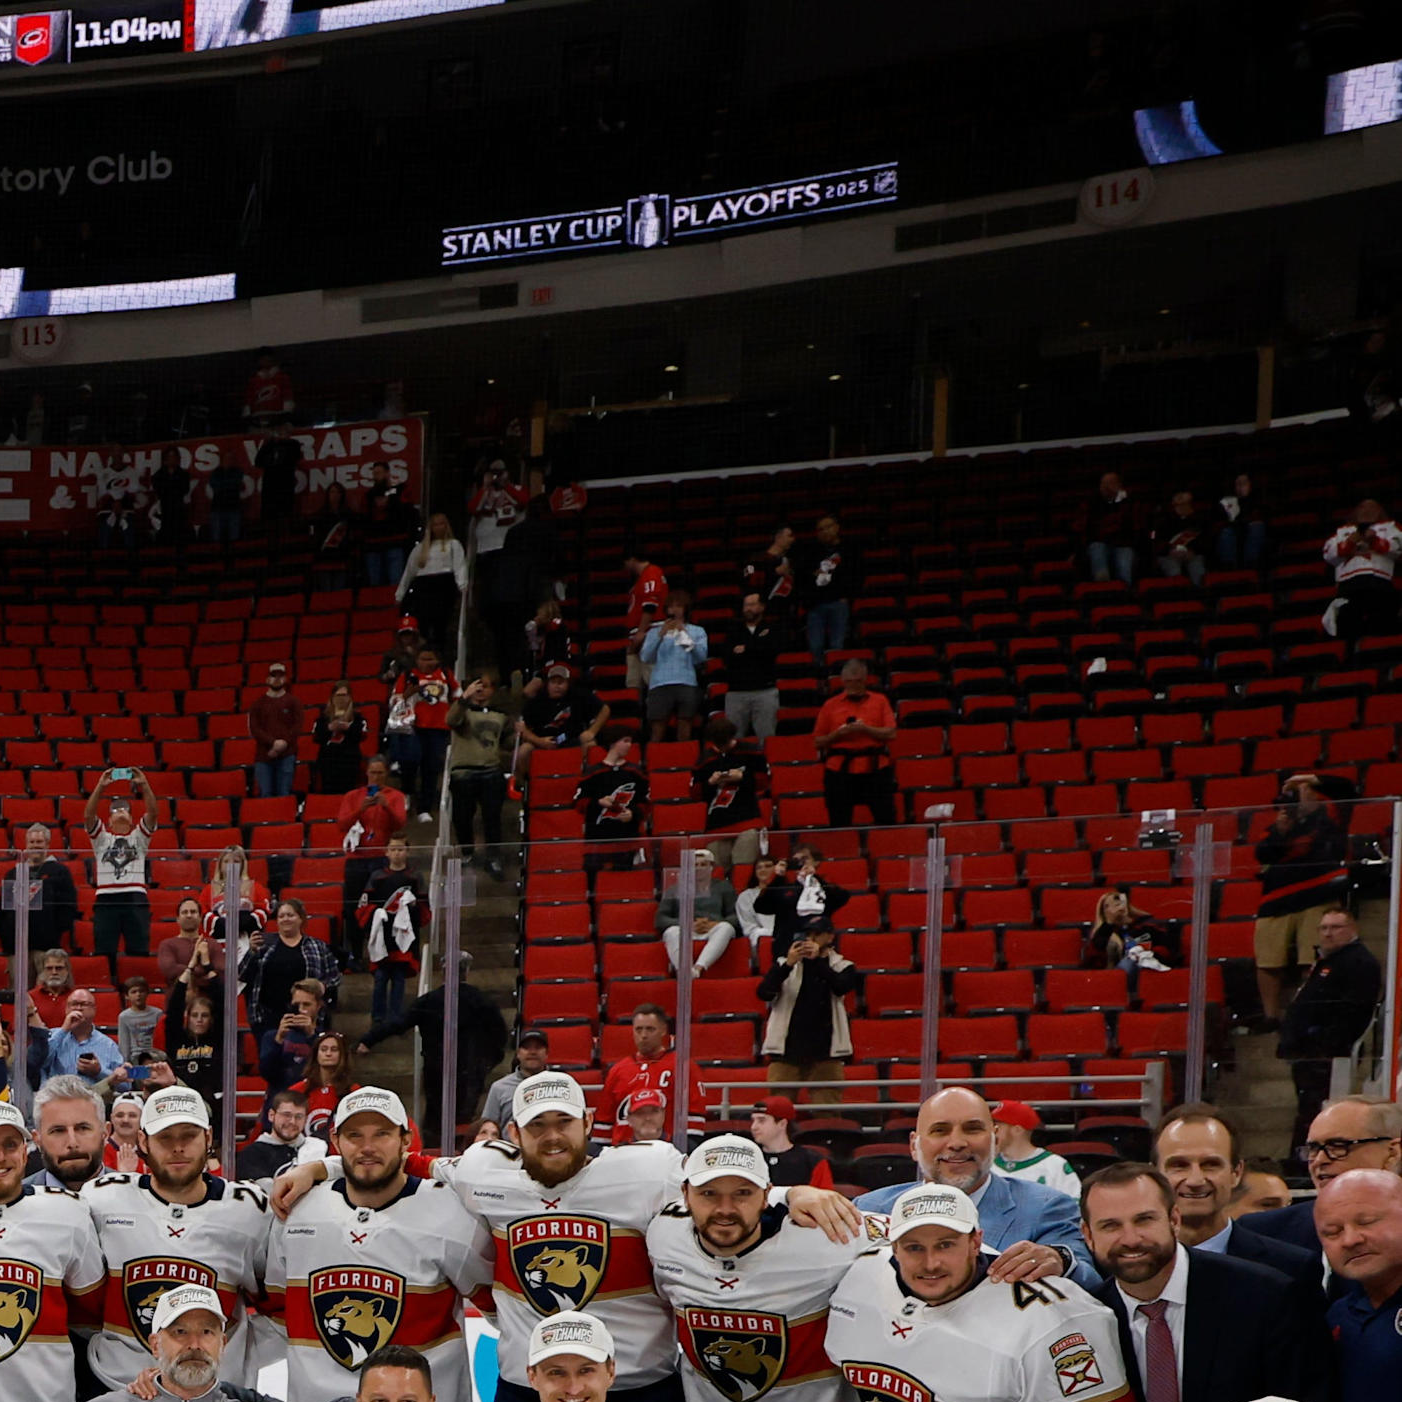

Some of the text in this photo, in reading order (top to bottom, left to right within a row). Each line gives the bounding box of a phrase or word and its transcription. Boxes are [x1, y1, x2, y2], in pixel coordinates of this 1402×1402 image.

[87, 150, 173, 185] Club
[1094, 179, 1140, 208] 114
[442, 178, 869, 258] STANLEY CUP PLAYOFFS 2025
[21, 323, 57, 347] 113
[49, 484, 76, 510] &
[358, 1097, 390, 1110] CHAMPS
[535, 1088, 570, 1102] CHAMPS
[168, 1100, 198, 1114] CHAMPS
[720, 1151, 756, 1167] CHAMPS
[917, 1198, 957, 1215] CHAMPS
[516, 1220, 598, 1241] FLORIDA
[132, 1263, 209, 1286] FLORIDA
[318, 1273, 394, 1293] FLORIDA
[182, 1291, 212, 1304] CHAMPS
[692, 1312, 775, 1333] FLORIDA
[556, 1328, 593, 1343] CHAMPS
